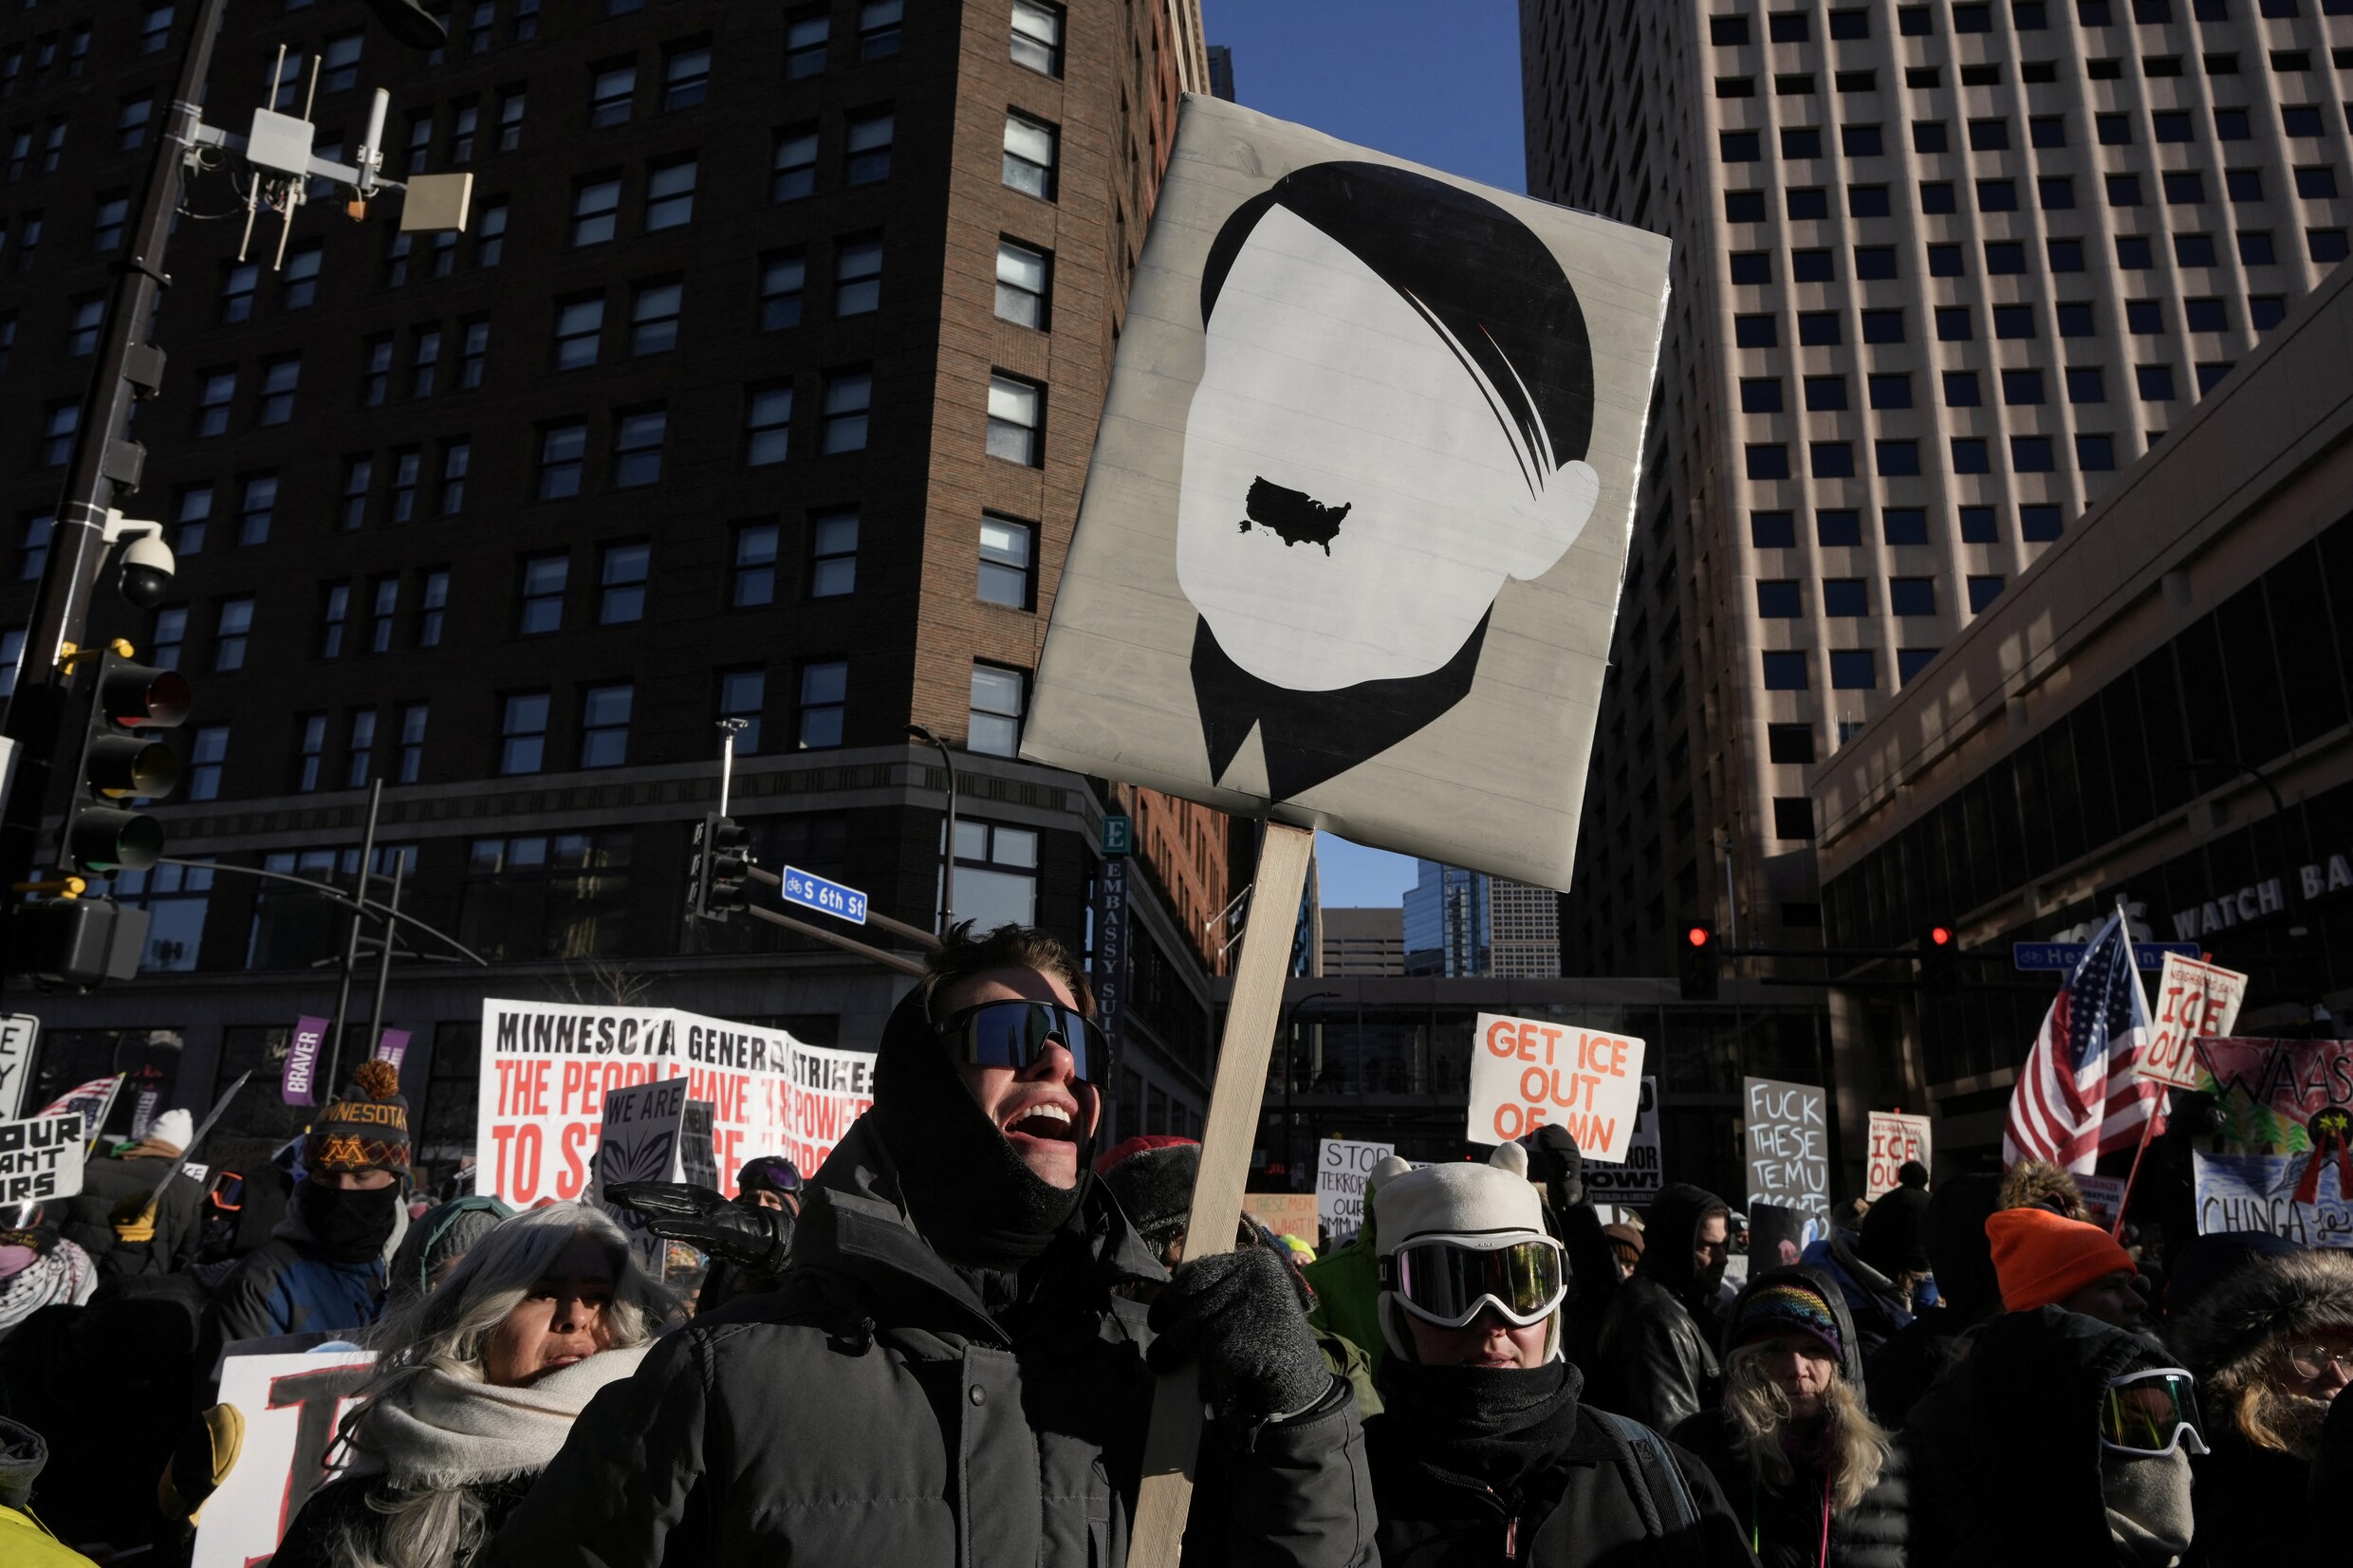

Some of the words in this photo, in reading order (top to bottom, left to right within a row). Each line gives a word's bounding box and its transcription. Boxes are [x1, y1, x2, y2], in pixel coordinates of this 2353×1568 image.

[804, 880, 814, 900] S
[819, 887, 843, 911] 6th
[848, 896, 863, 917] St
[1102, 862, 1122, 974] EMBASSY
[2173, 877, 2285, 942] WATCH
[496, 1012, 675, 1056] MINNESOTA
[2162, 987, 2227, 1037] ICE
[287, 1031, 319, 1093] BRAVER
[1487, 1021, 1563, 1065] GET
[1578, 1033, 1628, 1078] ICE
[495, 1060, 551, 1116] THE
[608, 1095, 637, 1126] WE
[640, 1087, 682, 1120] ARE
[1520, 1066, 1602, 1112] OUT
[1751, 1084, 1825, 1126] FUCK
[1493, 1102, 1547, 1144] OF
[1567, 1112, 1616, 1153] MN
[1749, 1123, 1826, 1161] THESE
[1871, 1134, 1918, 1162] ICE
[492, 1124, 542, 1204] TO
[1752, 1160, 1825, 1192] TEMU
[1253, 1196, 1287, 1213] THESE
[1288, 1197, 1313, 1211] MEN
[2203, 1196, 2307, 1245] CHINGA
